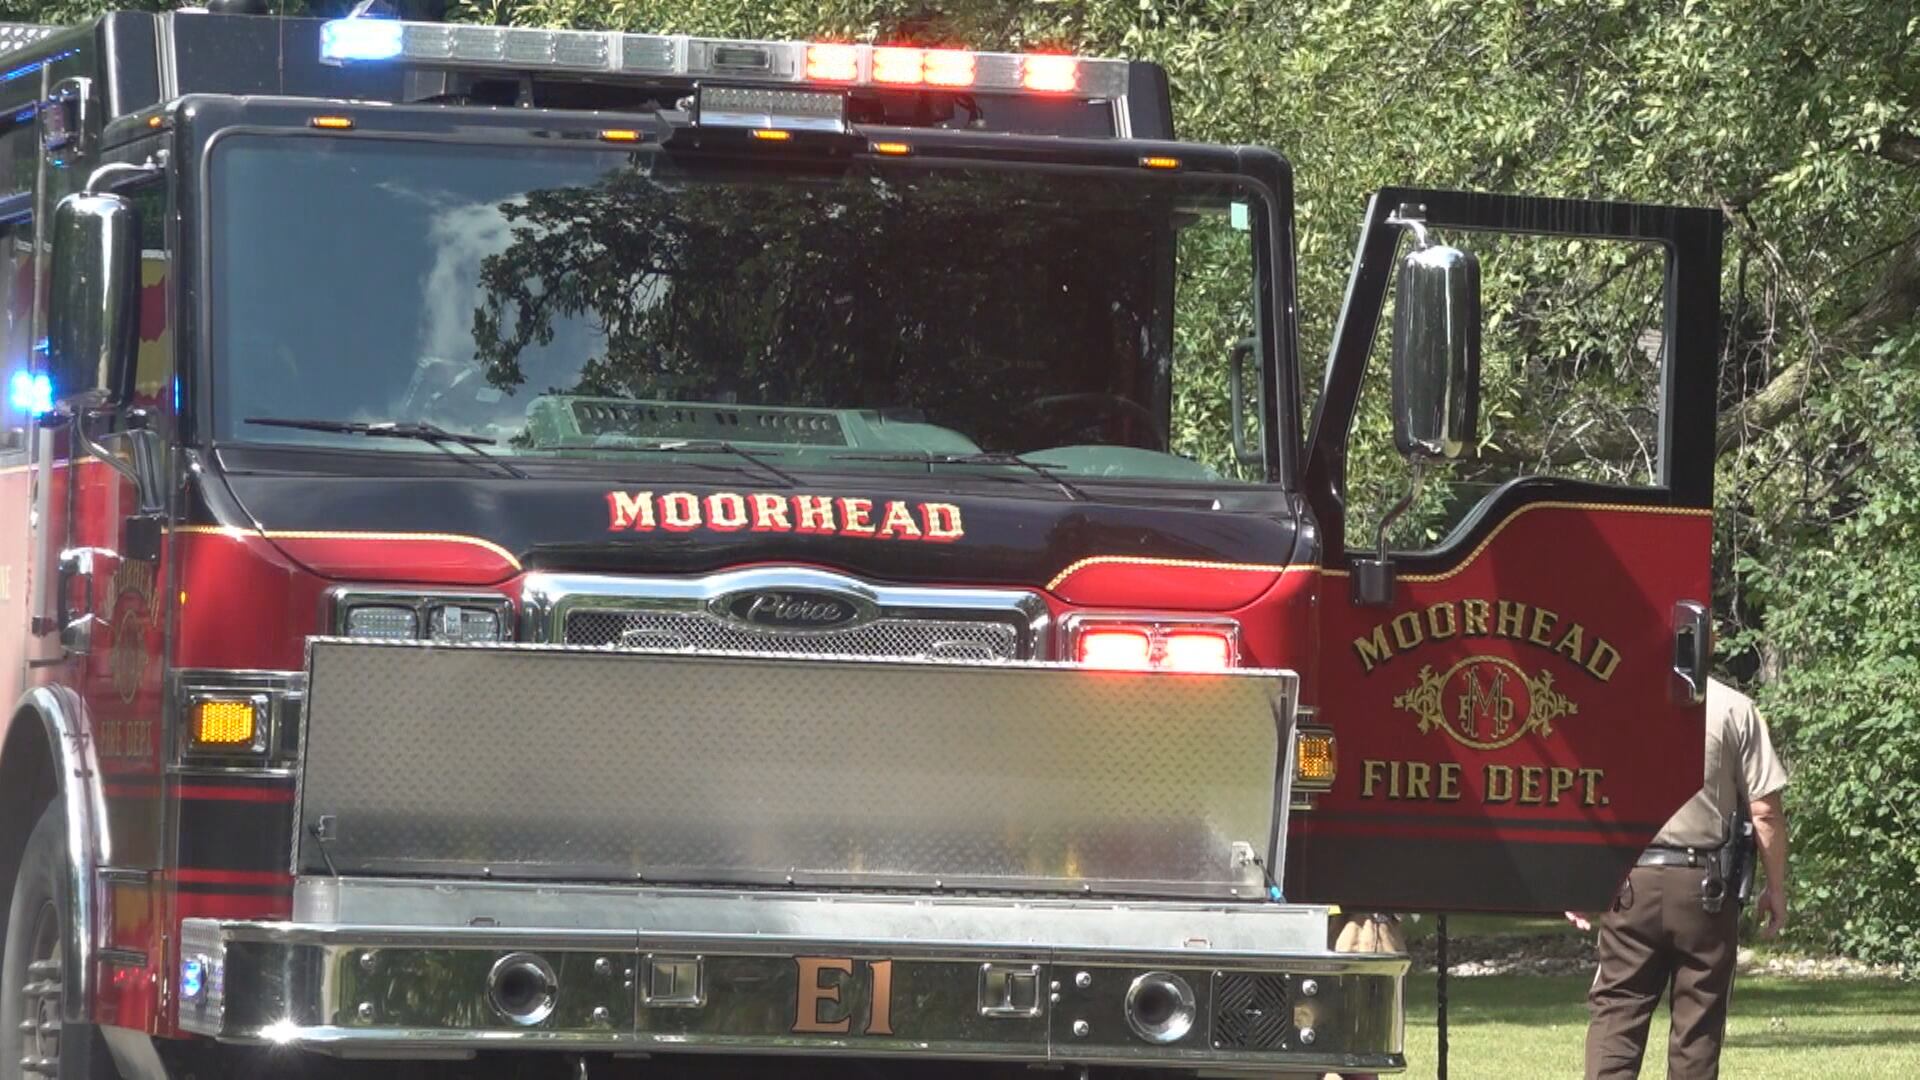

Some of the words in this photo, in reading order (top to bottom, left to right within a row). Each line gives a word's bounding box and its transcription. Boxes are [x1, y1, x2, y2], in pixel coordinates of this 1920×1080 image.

[608, 490, 963, 540] MOORHEAD
[747, 595, 842, 621] Pierce
[1353, 598, 1622, 682] MOORHEAD
[1362, 760, 1462, 800] FIRE
[1485, 764, 1610, 805] DEPT.
[792, 955, 894, 1035] E1
